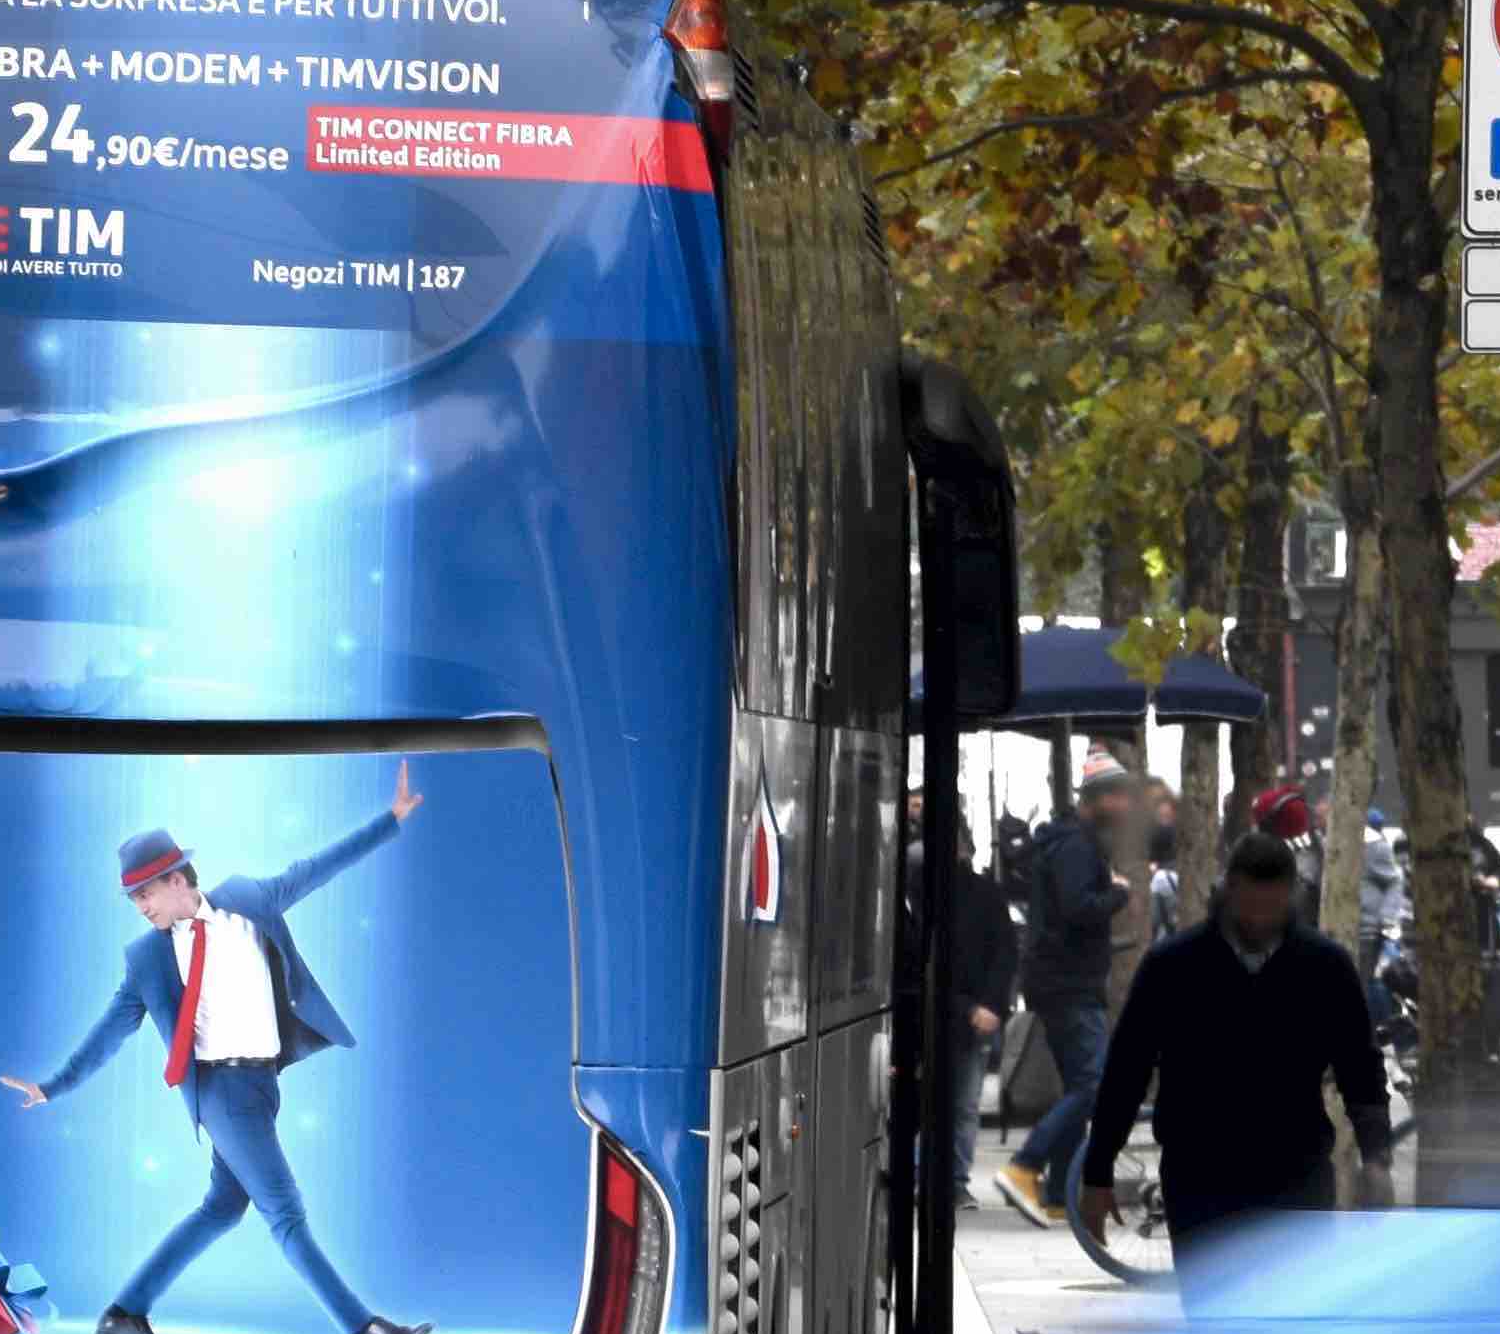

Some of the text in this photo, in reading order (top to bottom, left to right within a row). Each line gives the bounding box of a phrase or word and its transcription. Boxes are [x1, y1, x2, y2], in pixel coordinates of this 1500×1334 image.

[110, 50, 261, 85] MODEM
[296, 56, 500, 95] TIMVISION
[317, 116, 574, 148] TIM CONNECT FIBRA
[316, 142, 501, 171] Limited Edition
[20, 207, 125, 256] TIM
[12, 259, 64, 276] AVERE
[68, 261, 123, 278] TUTTO
[253, 259, 466, 290] Negozi TIM 187
